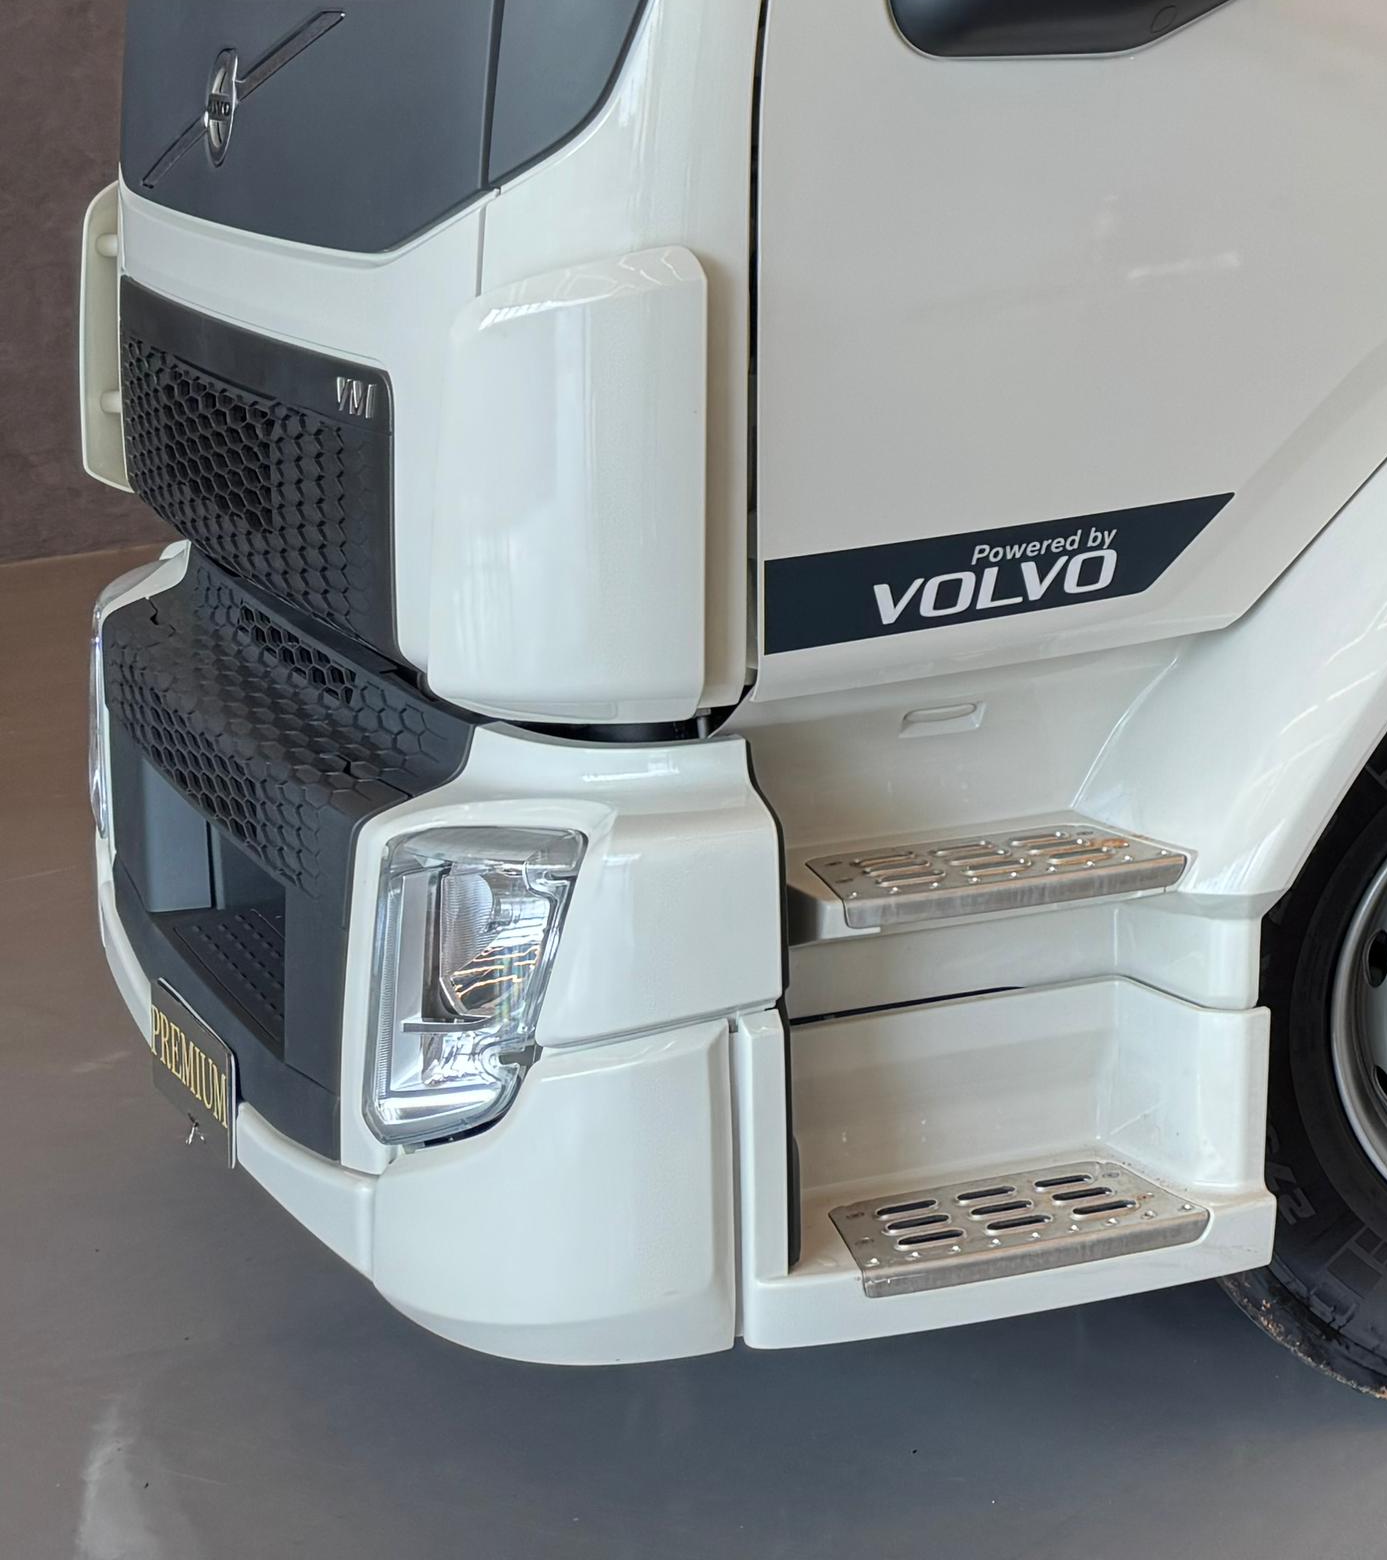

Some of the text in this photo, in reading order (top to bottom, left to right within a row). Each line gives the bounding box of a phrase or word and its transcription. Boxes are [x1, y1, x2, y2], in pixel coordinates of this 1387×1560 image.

[970, 526, 1118, 566] Powered by
[873, 549, 1119, 625] VOLVO
[151, 1003, 228, 1129] PREMIUM
